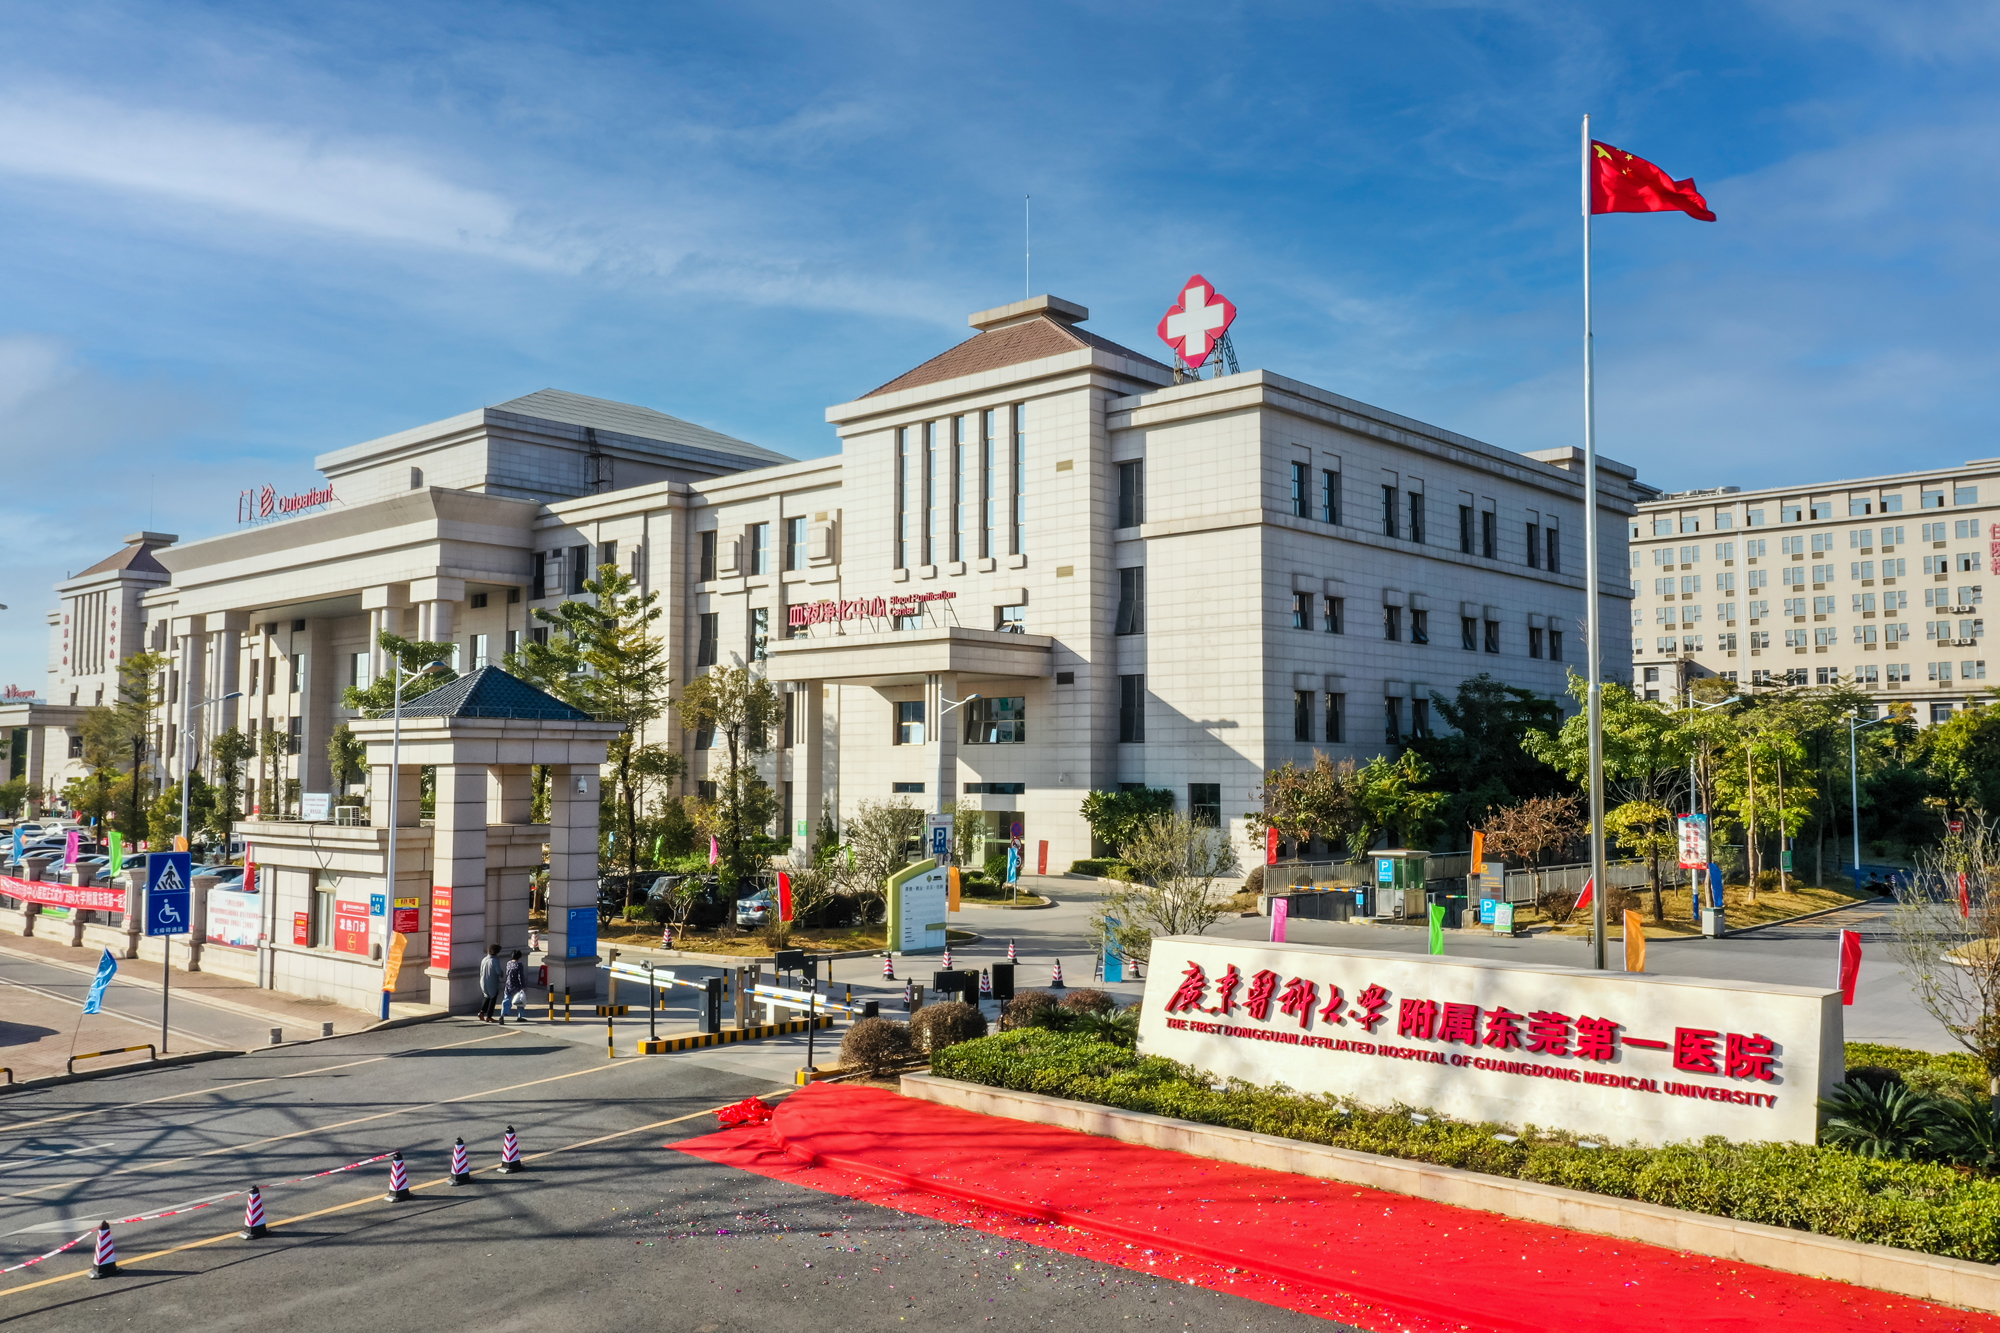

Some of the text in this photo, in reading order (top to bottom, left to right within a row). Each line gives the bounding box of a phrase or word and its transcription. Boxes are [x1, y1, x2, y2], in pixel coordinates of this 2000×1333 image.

[278, 483, 333, 513] Outpatient
[890, 590, 957, 605] Blood Purification
[789, 596, 886, 626] 血液净化中心
[890, 606, 916, 616] Center
[936, 829, 944, 845] P
[1382, 862, 1388, 871] P
[1480, 863, 1488, 874] P
[375, 904, 380, 913] 42
[1484, 901, 1492, 911] P
[571, 911, 576, 920] P
[339, 918, 367, 933] 发热门诊
[1165, 1017, 1778, 1108] THE FIRST DONGGUAN AFFILIATED HOSPITAL OF GUANGDONG MEDICAL UNIVERSITY
